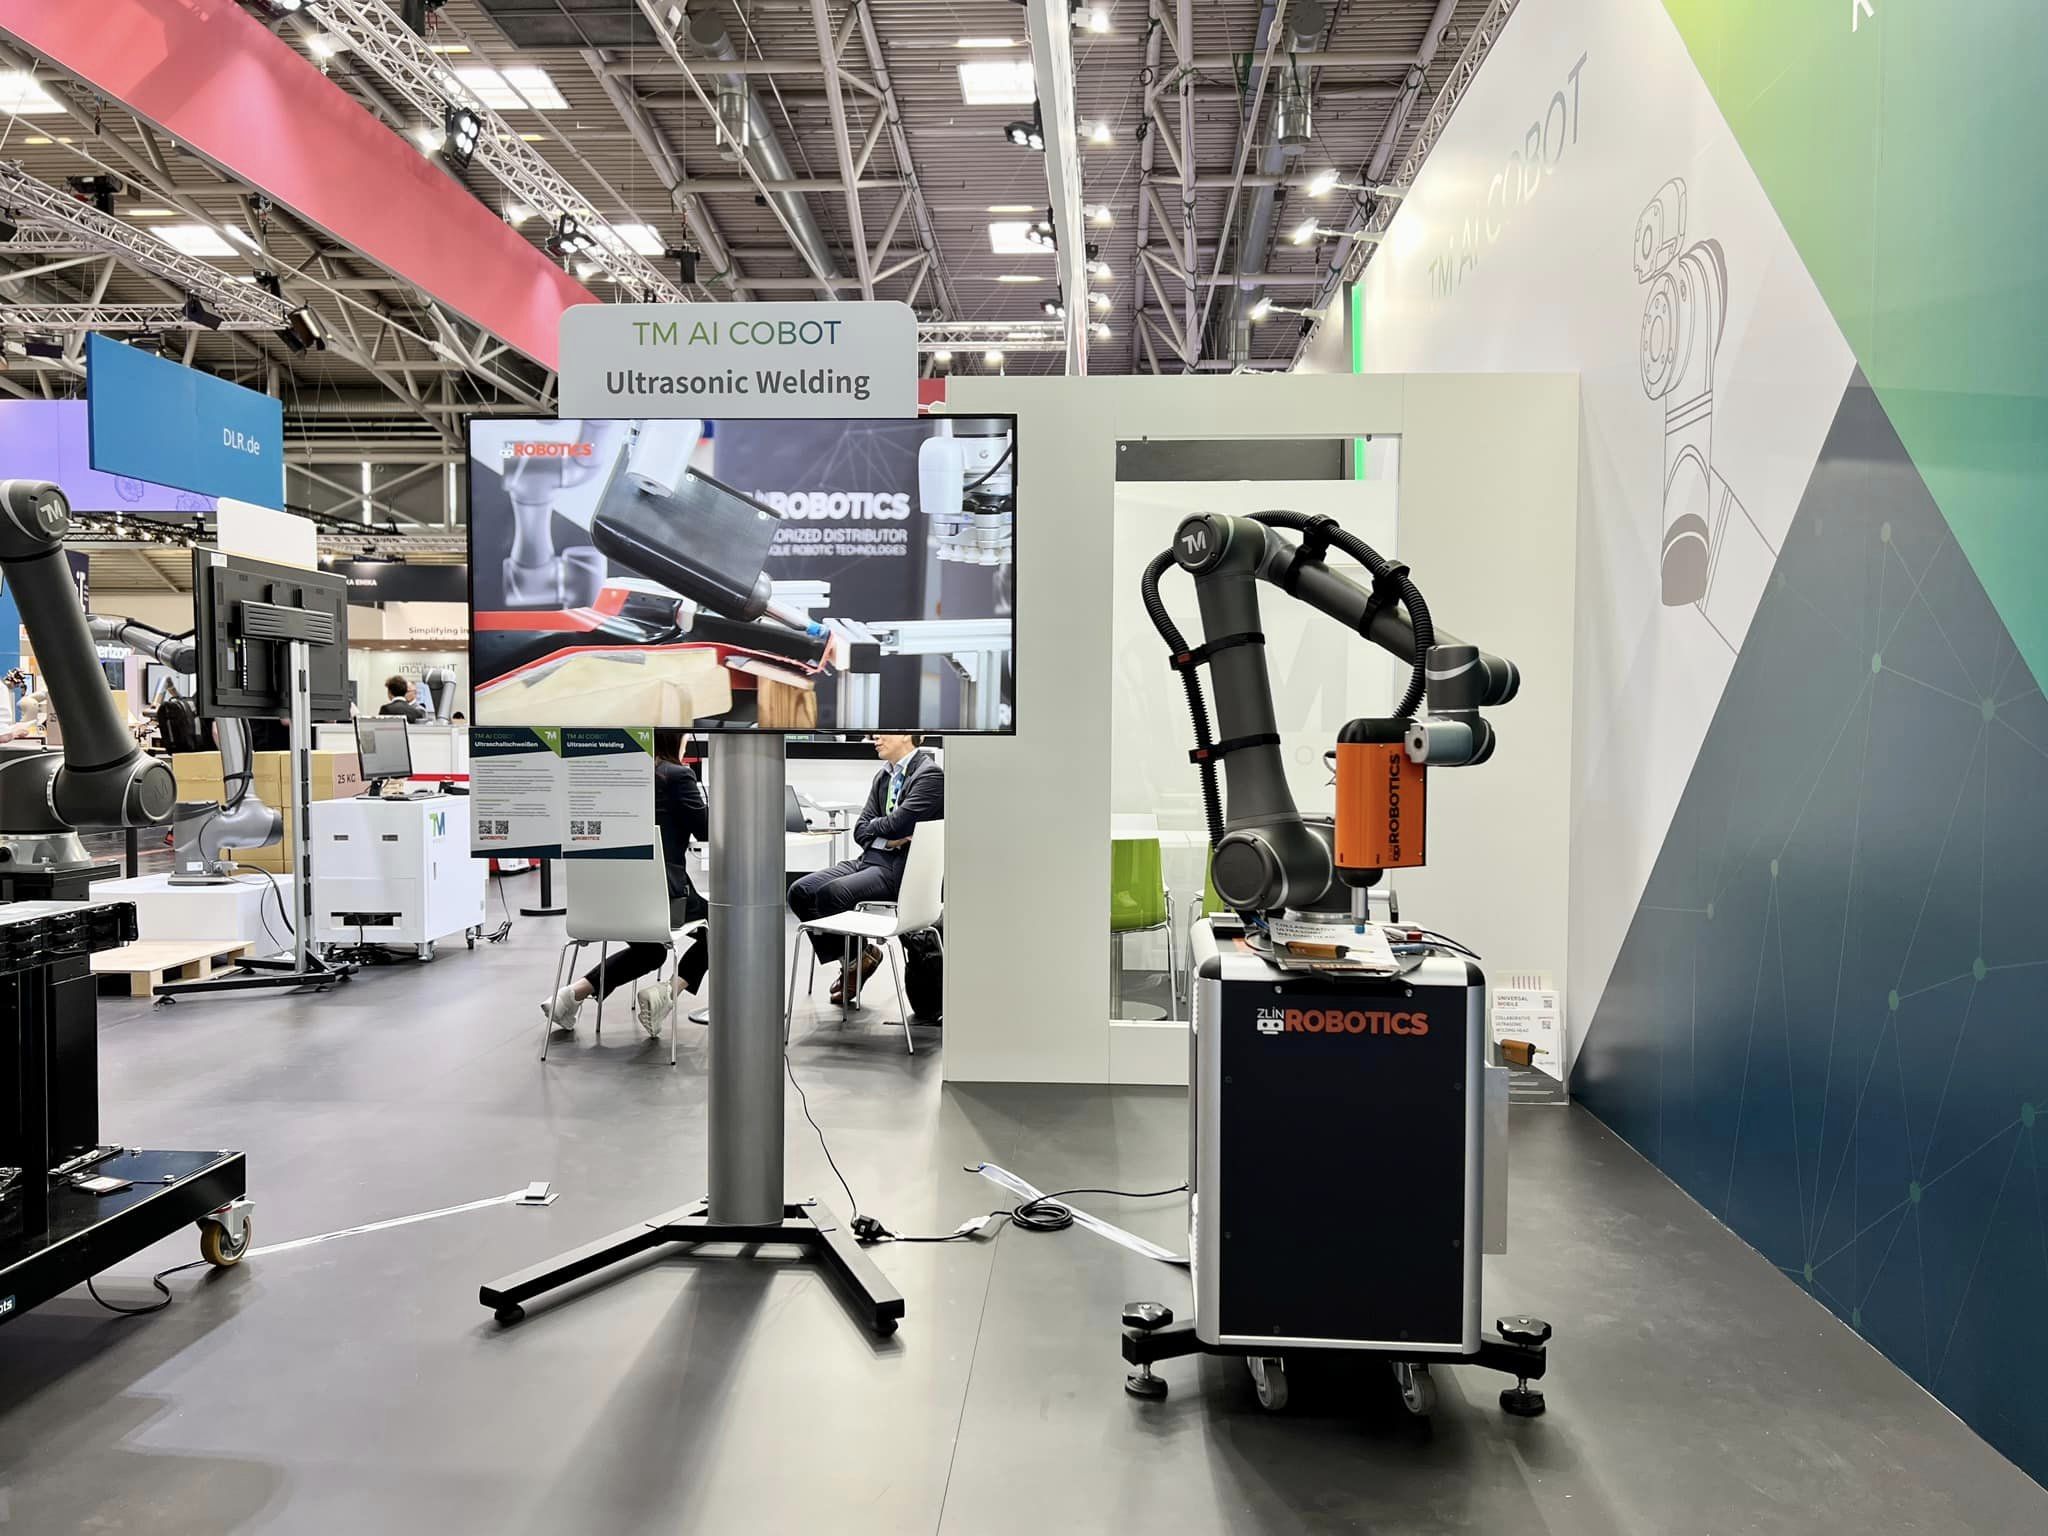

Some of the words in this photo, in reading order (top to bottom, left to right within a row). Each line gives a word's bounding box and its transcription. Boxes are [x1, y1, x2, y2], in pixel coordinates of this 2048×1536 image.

[1486, 50, 1588, 245] COBOT
[632, 321, 678, 346] TM
[688, 320, 718, 345] AI
[729, 320, 842, 345] COBOT
[606, 369, 749, 394] Ultrasonic
[756, 368, 871, 400] Welding
[223, 427, 260, 456] DLR.de
[513, 442, 592, 458] ROBOTICS
[40, 499, 64, 523] TM
[767, 491, 911, 520] ROBOTICS
[773, 528, 822, 544] ORIZED
[823, 528, 908, 544] DISTRIBUTOR
[1182, 530, 1207, 555] TM
[792, 544, 834, 556] ROBOTIC
[835, 544, 908, 556] TECHNOLOGIES
[408, 626, 458, 635] Simplifying
[599, 741, 625, 749] Welding
[337, 774, 346, 784] 25
[346, 773, 356, 783] KG
[1388, 753, 1400, 843] ROBOTICS
[429, 811, 446, 837] TM
[1285, 1009, 1429, 1036] ROBOTICS
